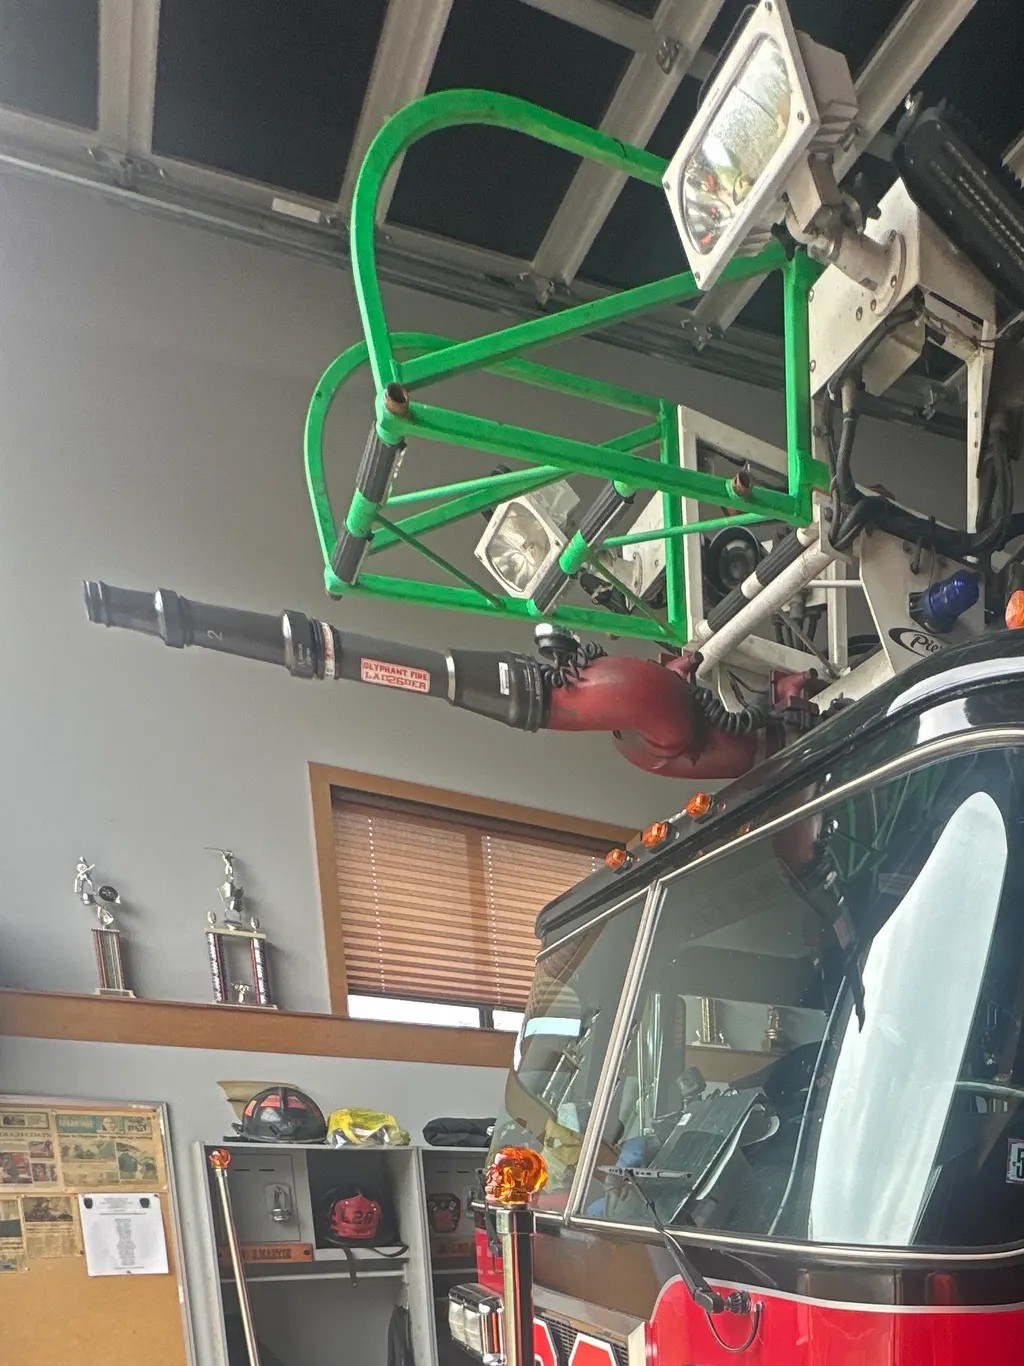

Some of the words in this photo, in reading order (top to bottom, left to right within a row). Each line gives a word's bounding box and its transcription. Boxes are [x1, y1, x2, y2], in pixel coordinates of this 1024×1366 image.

[363, 661, 408, 677] OLYPHANT
[410, 670, 428, 681] FIRE
[364, 671, 427, 691] LAD26DER
